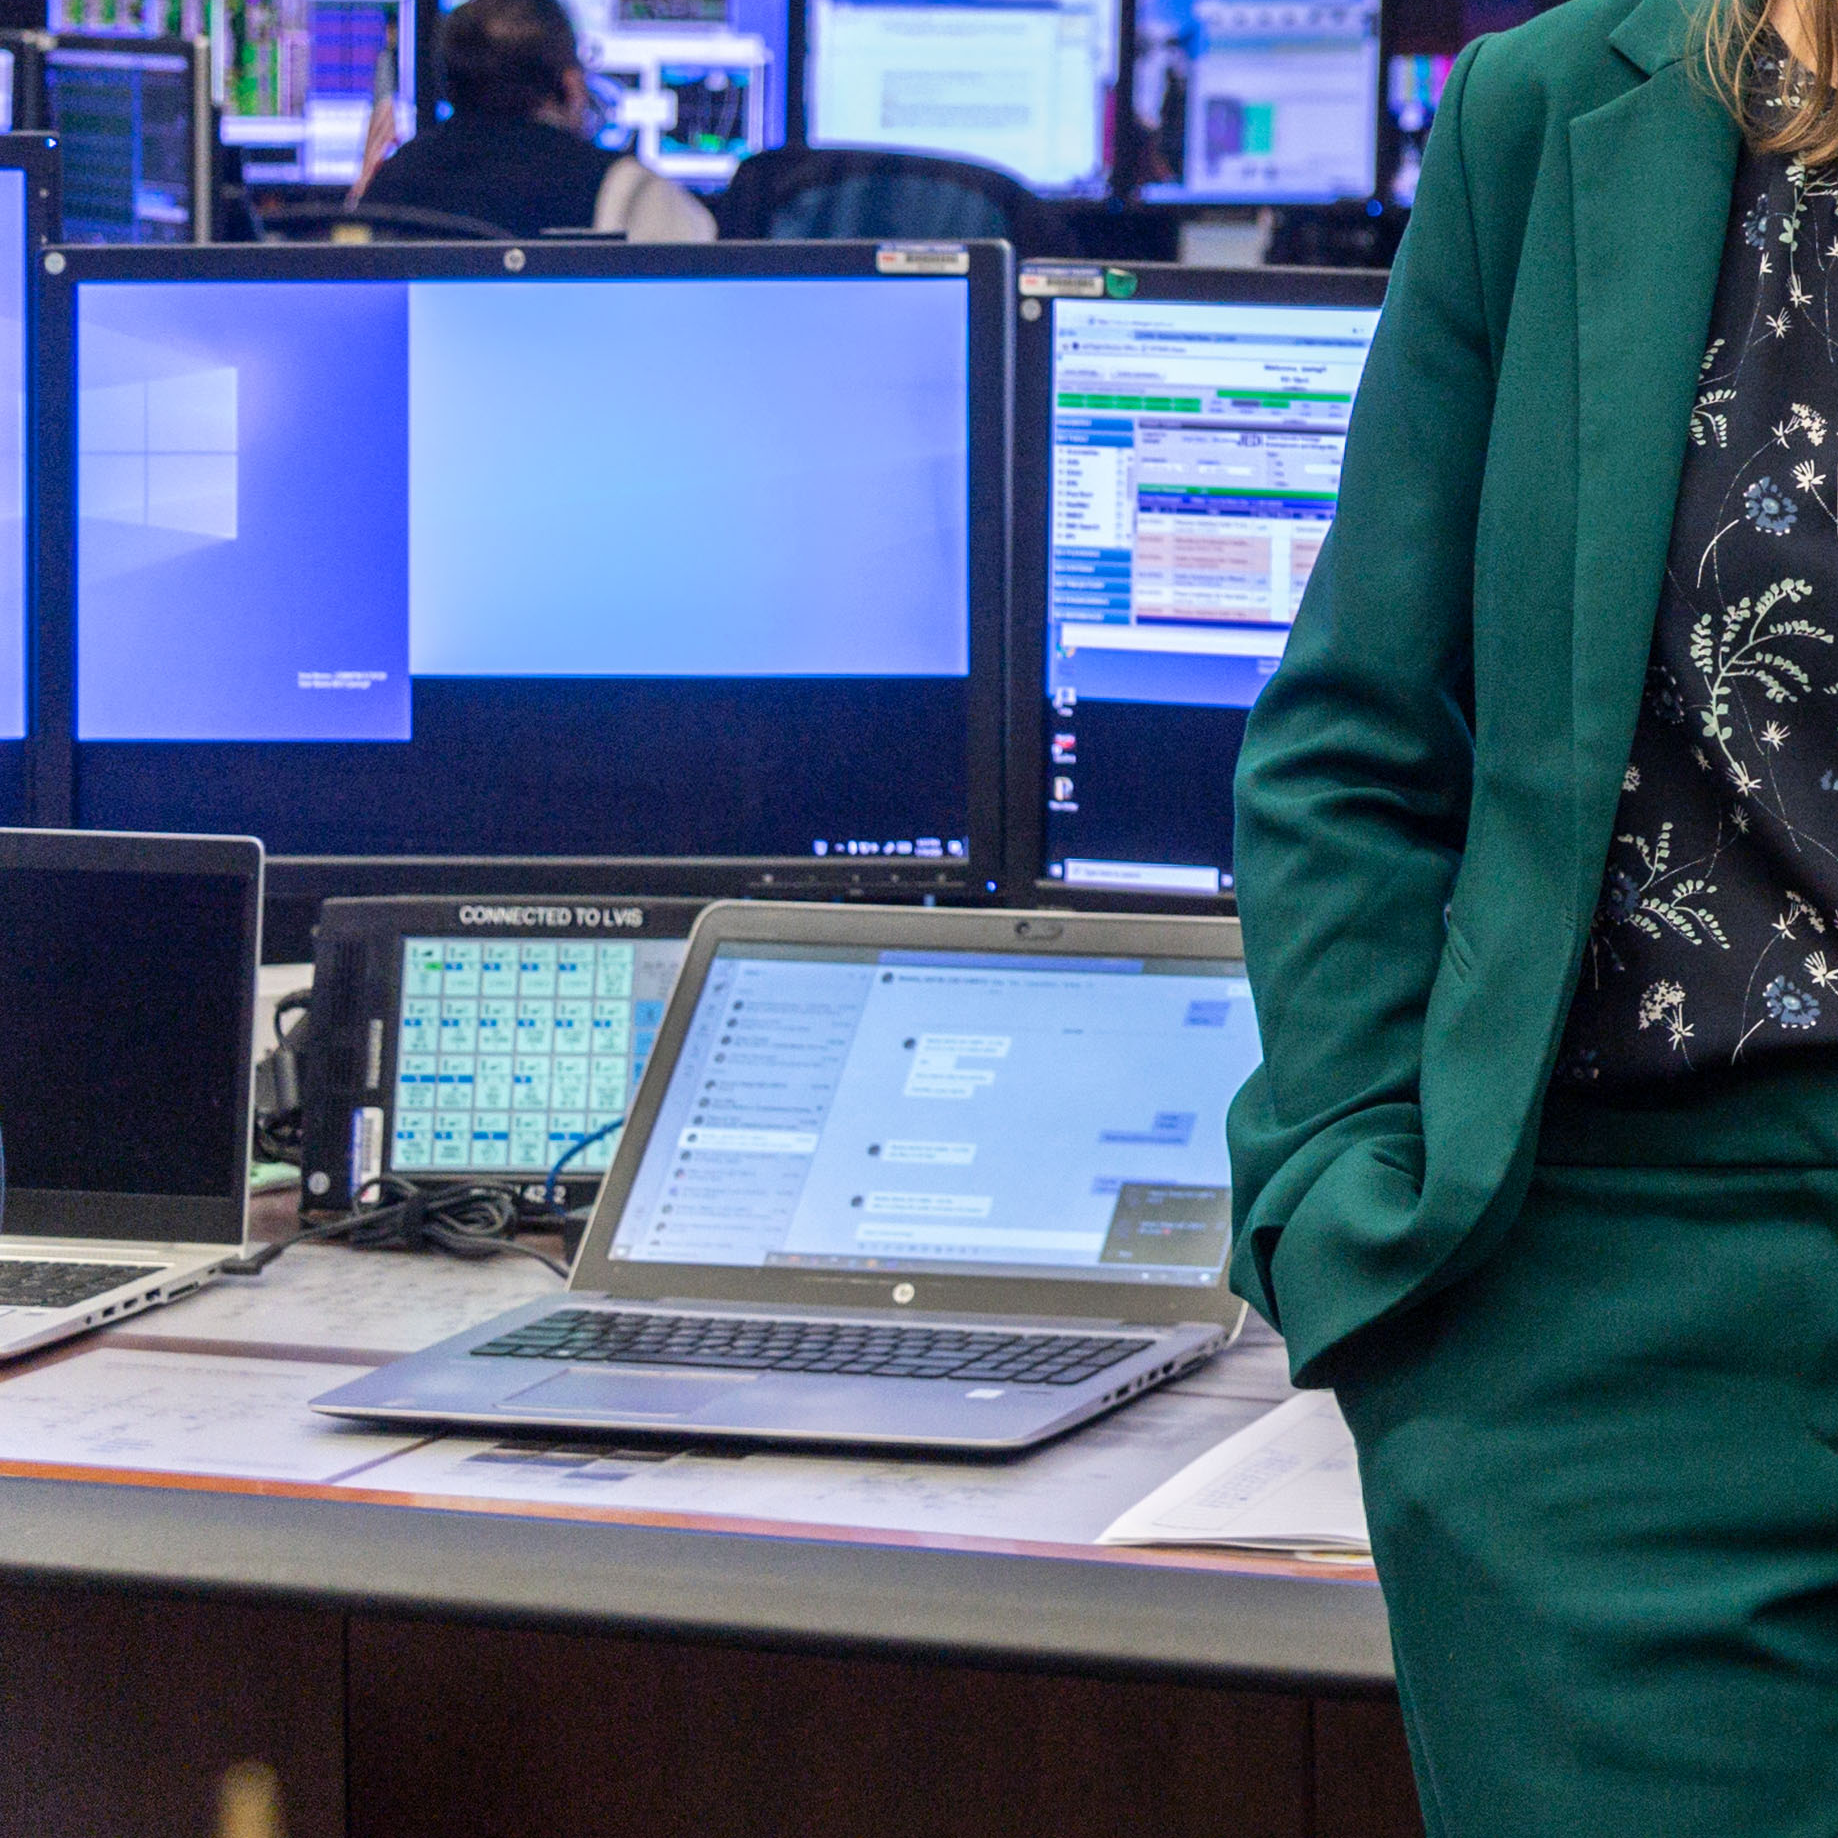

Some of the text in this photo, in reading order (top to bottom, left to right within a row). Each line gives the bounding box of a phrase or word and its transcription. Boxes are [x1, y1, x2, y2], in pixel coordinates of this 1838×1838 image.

[459, 905, 644, 928] CONNECTED TO LVIS
